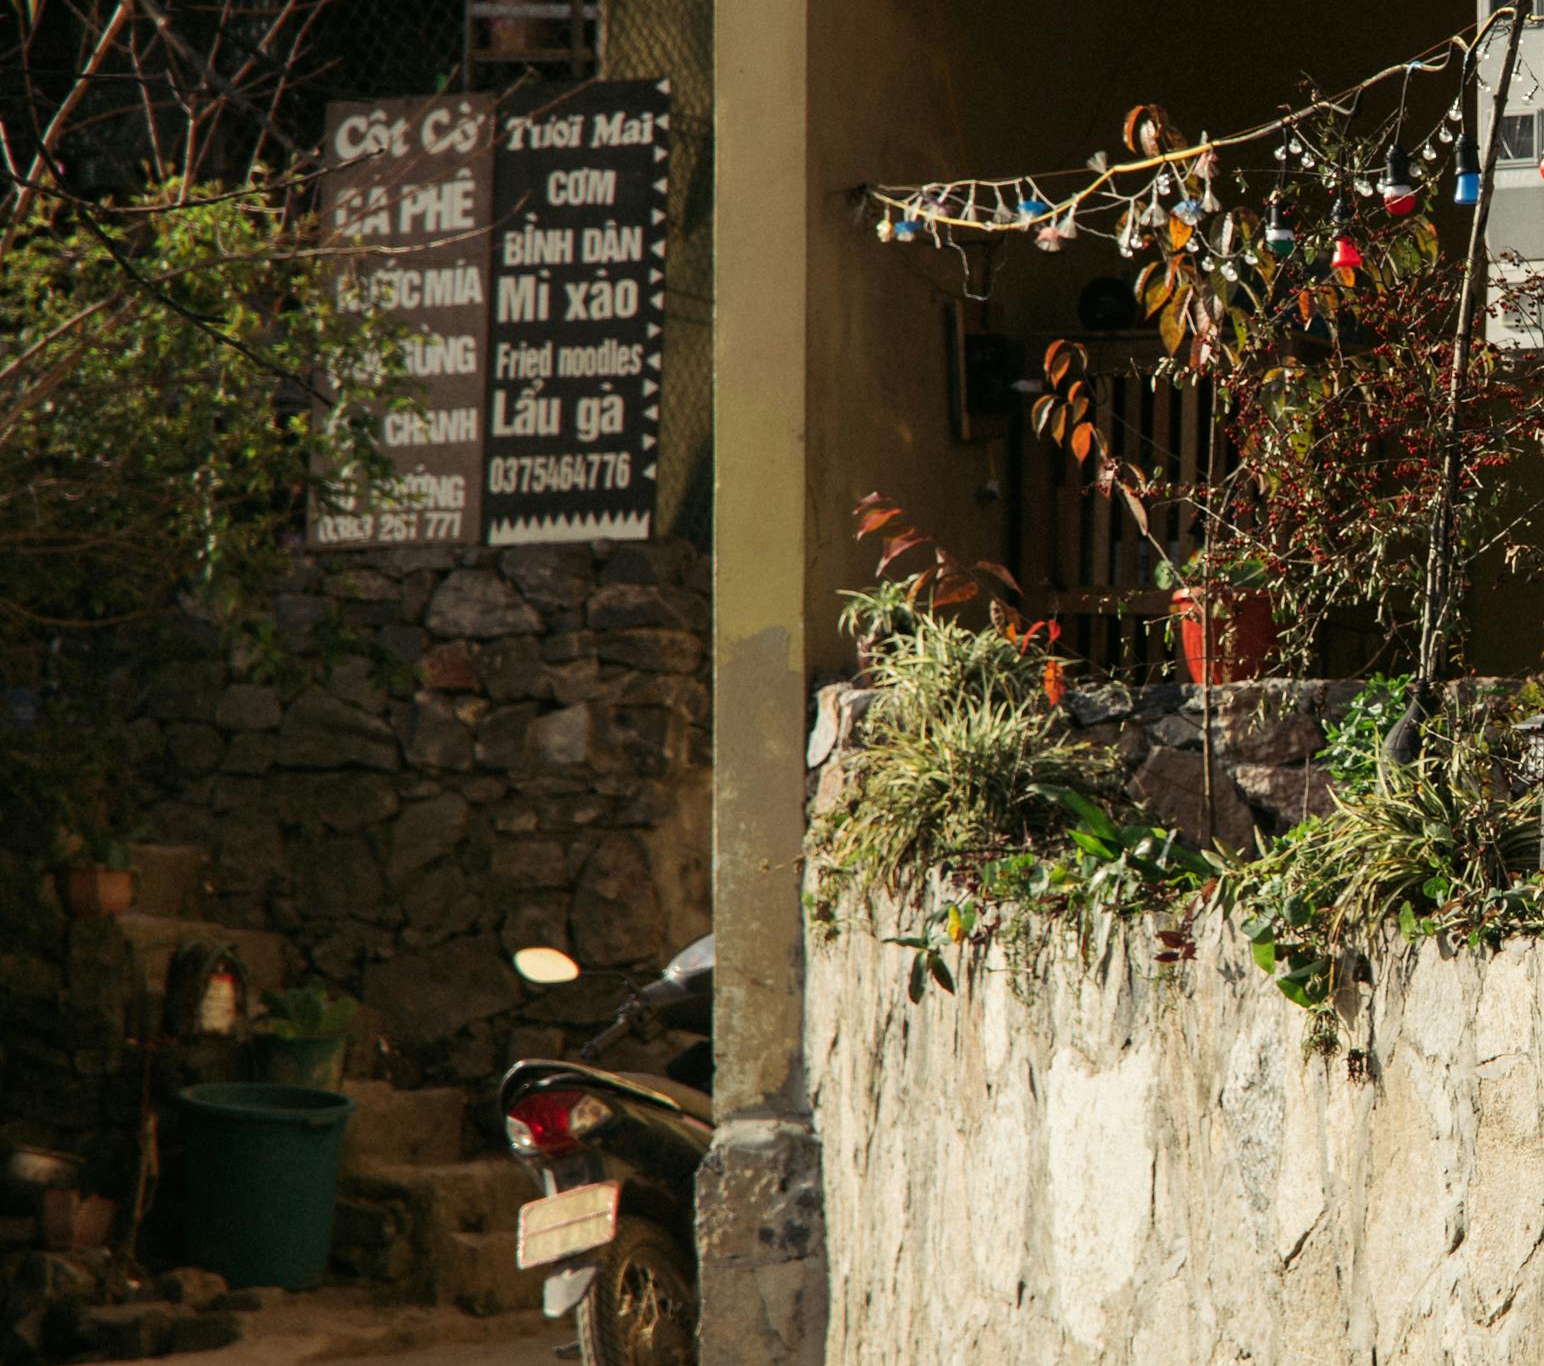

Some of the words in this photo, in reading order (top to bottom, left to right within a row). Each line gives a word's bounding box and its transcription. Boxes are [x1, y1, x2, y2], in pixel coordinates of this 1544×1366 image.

[590, 111, 654, 149] Mai
[400, 168, 476, 234] PHÊ
[548, 167, 616, 205] CƠM
[504, 212, 574, 266] BÌNH
[582, 219, 643, 263] DÂN
[423, 259, 483, 308] MÍA
[497, 269, 551, 323] Mì
[564, 268, 638, 321] xào
[496, 340, 553, 380] Fried
[558, 338, 644, 378] noodles
[493, 379, 562, 437] Lẩu
[576, 381, 624, 442] gà
[424, 510, 463, 540] 771
